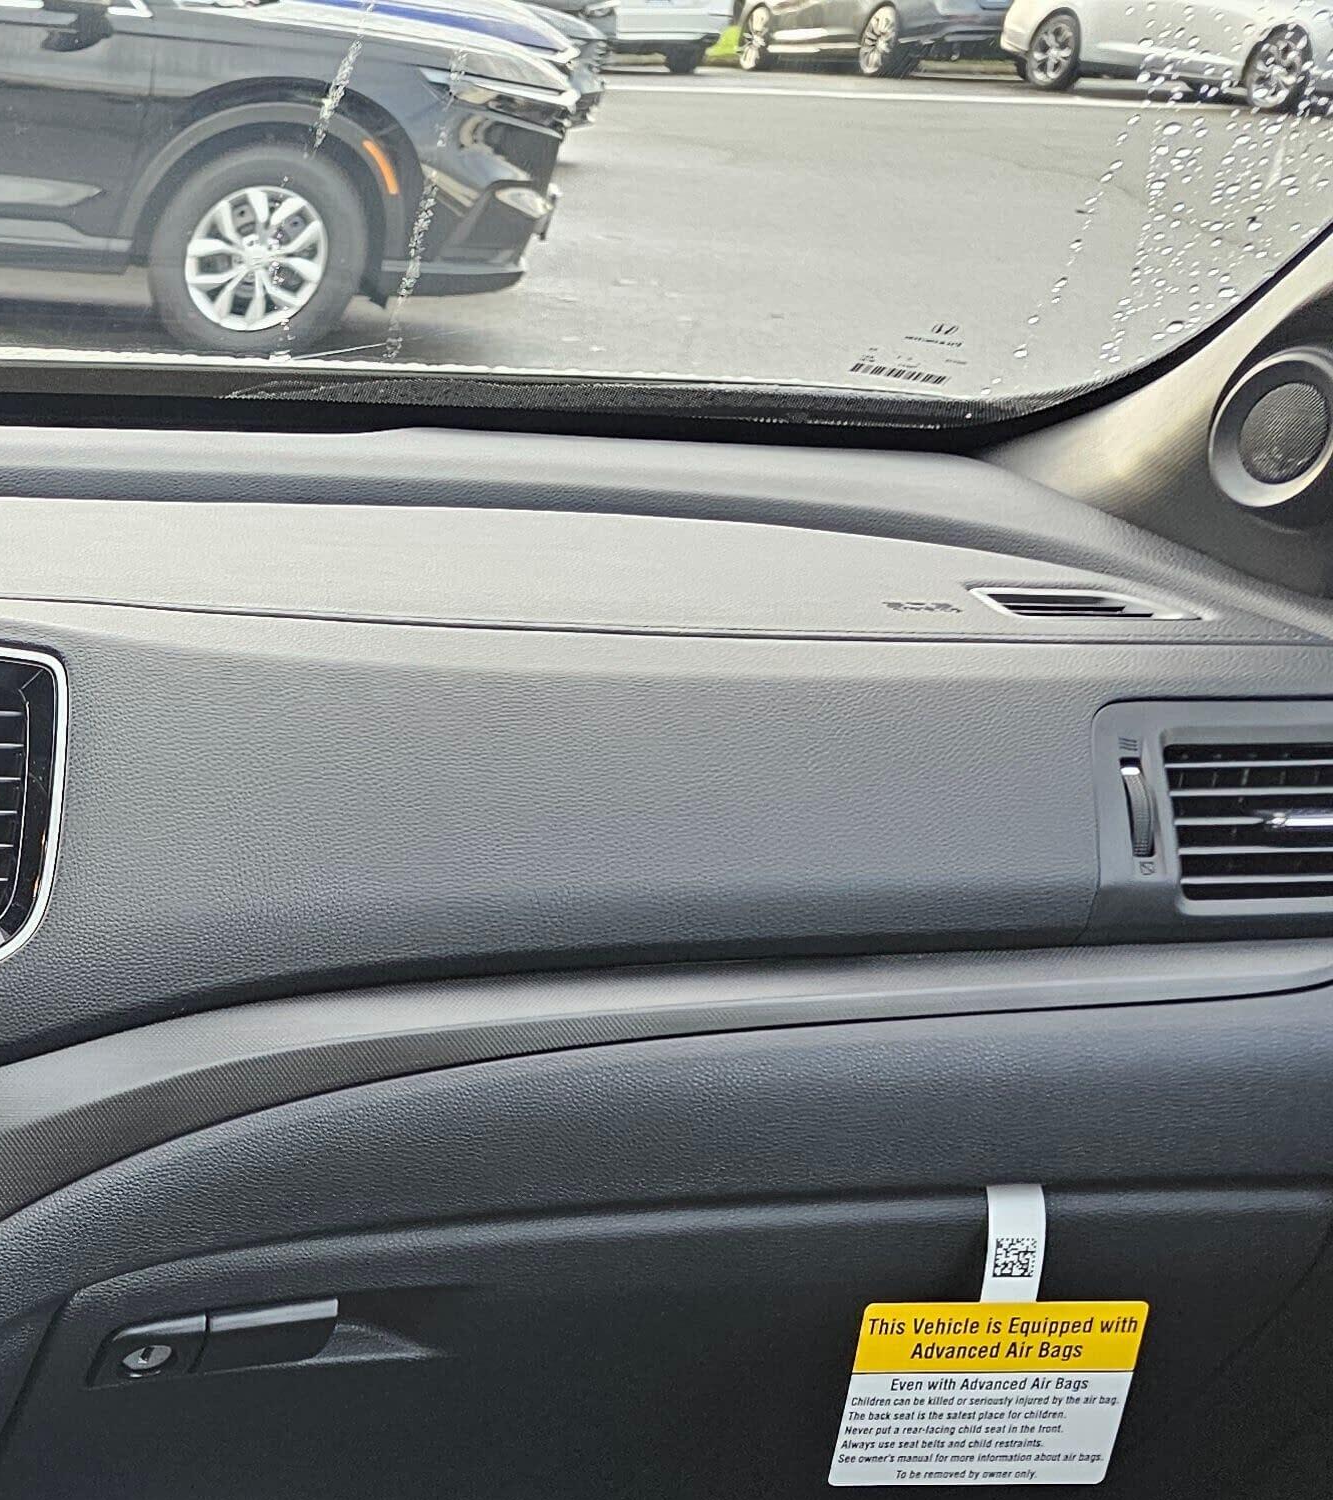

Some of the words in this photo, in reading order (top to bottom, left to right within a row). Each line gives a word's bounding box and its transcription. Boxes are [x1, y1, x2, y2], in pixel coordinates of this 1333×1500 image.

[868, 1318, 905, 1335] This
[913, 1317, 979, 1335] Vehicle
[986, 1317, 1001, 1334] is
[1007, 1316, 1093, 1338] Equipped
[1100, 1316, 1138, 1333] with
[911, 1342, 1000, 1359] Advanced
[1005, 1342, 1033, 1358] Air
[1037, 1341, 1083, 1361] Bags
[890, 1378, 923, 1391] Even
[927, 1378, 956, 1390] with
[960, 1377, 1028, 1391] Advanced
[1030, 1377, 1052, 1390] Air
[1055, 1377, 1089, 1392] Bags
[851, 1397, 891, 1406] Children
[913, 1397, 924, 1406] be
[927, 1396, 954, 1405] killed
[968, 1396, 1013, 1407] seriously
[1015, 1396, 1050, 1407] injured
[1052, 1396, 1063, 1406] by
[1065, 1396, 1080, 1404] the
[1082, 1396, 1097, 1404] air
[1098, 1396, 1120, 1406] bag.
[848, 1411, 865, 1420] The
[868, 1411, 891, 1420] back
[893, 1411, 915, 1420] seat
[917, 1411, 926, 1420] is
[928, 1411, 944, 1420] the
[946, 1411, 976, 1420] safest
[978, 1411, 1005, 1421] place
[1007, 1410, 1022, 1419] for
[1024, 1410, 1067, 1419] children.
[844, 1426, 874, 1435] Never
[875, 1426, 892, 1436] put
[902, 1425, 956, 1436] rear-facing
[958, 1425, 982, 1434] child
[984, 1425, 1006, 1434] seat
[1007, 1425, 1017, 1433] in
[1020, 1424, 1035, 1433] the
[841, 1440, 875, 1450] Always
[878, 1441, 894, 1449] use
[898, 1440, 920, 1449] seat
[921, 1439, 945, 1449] belts
[947, 1440, 966, 1448] and
[968, 1439, 992, 1448] child
[994, 1439, 1044, 1448] restraints.
[838, 1454, 856, 1463] See
[858, 1454, 895, 1463] owner's
[897, 1454, 933, 1463] manual
[935, 1454, 948, 1463] for
[977, 1453, 1032, 1462] information
[1034, 1453, 1060, 1462] about
[1064, 1453, 1077, 1462] air
[896, 1470, 906, 1479] To
[909, 1470, 920, 1479] be
[924, 1470, 966, 1479] removed
[968, 1470, 979, 1480] by
